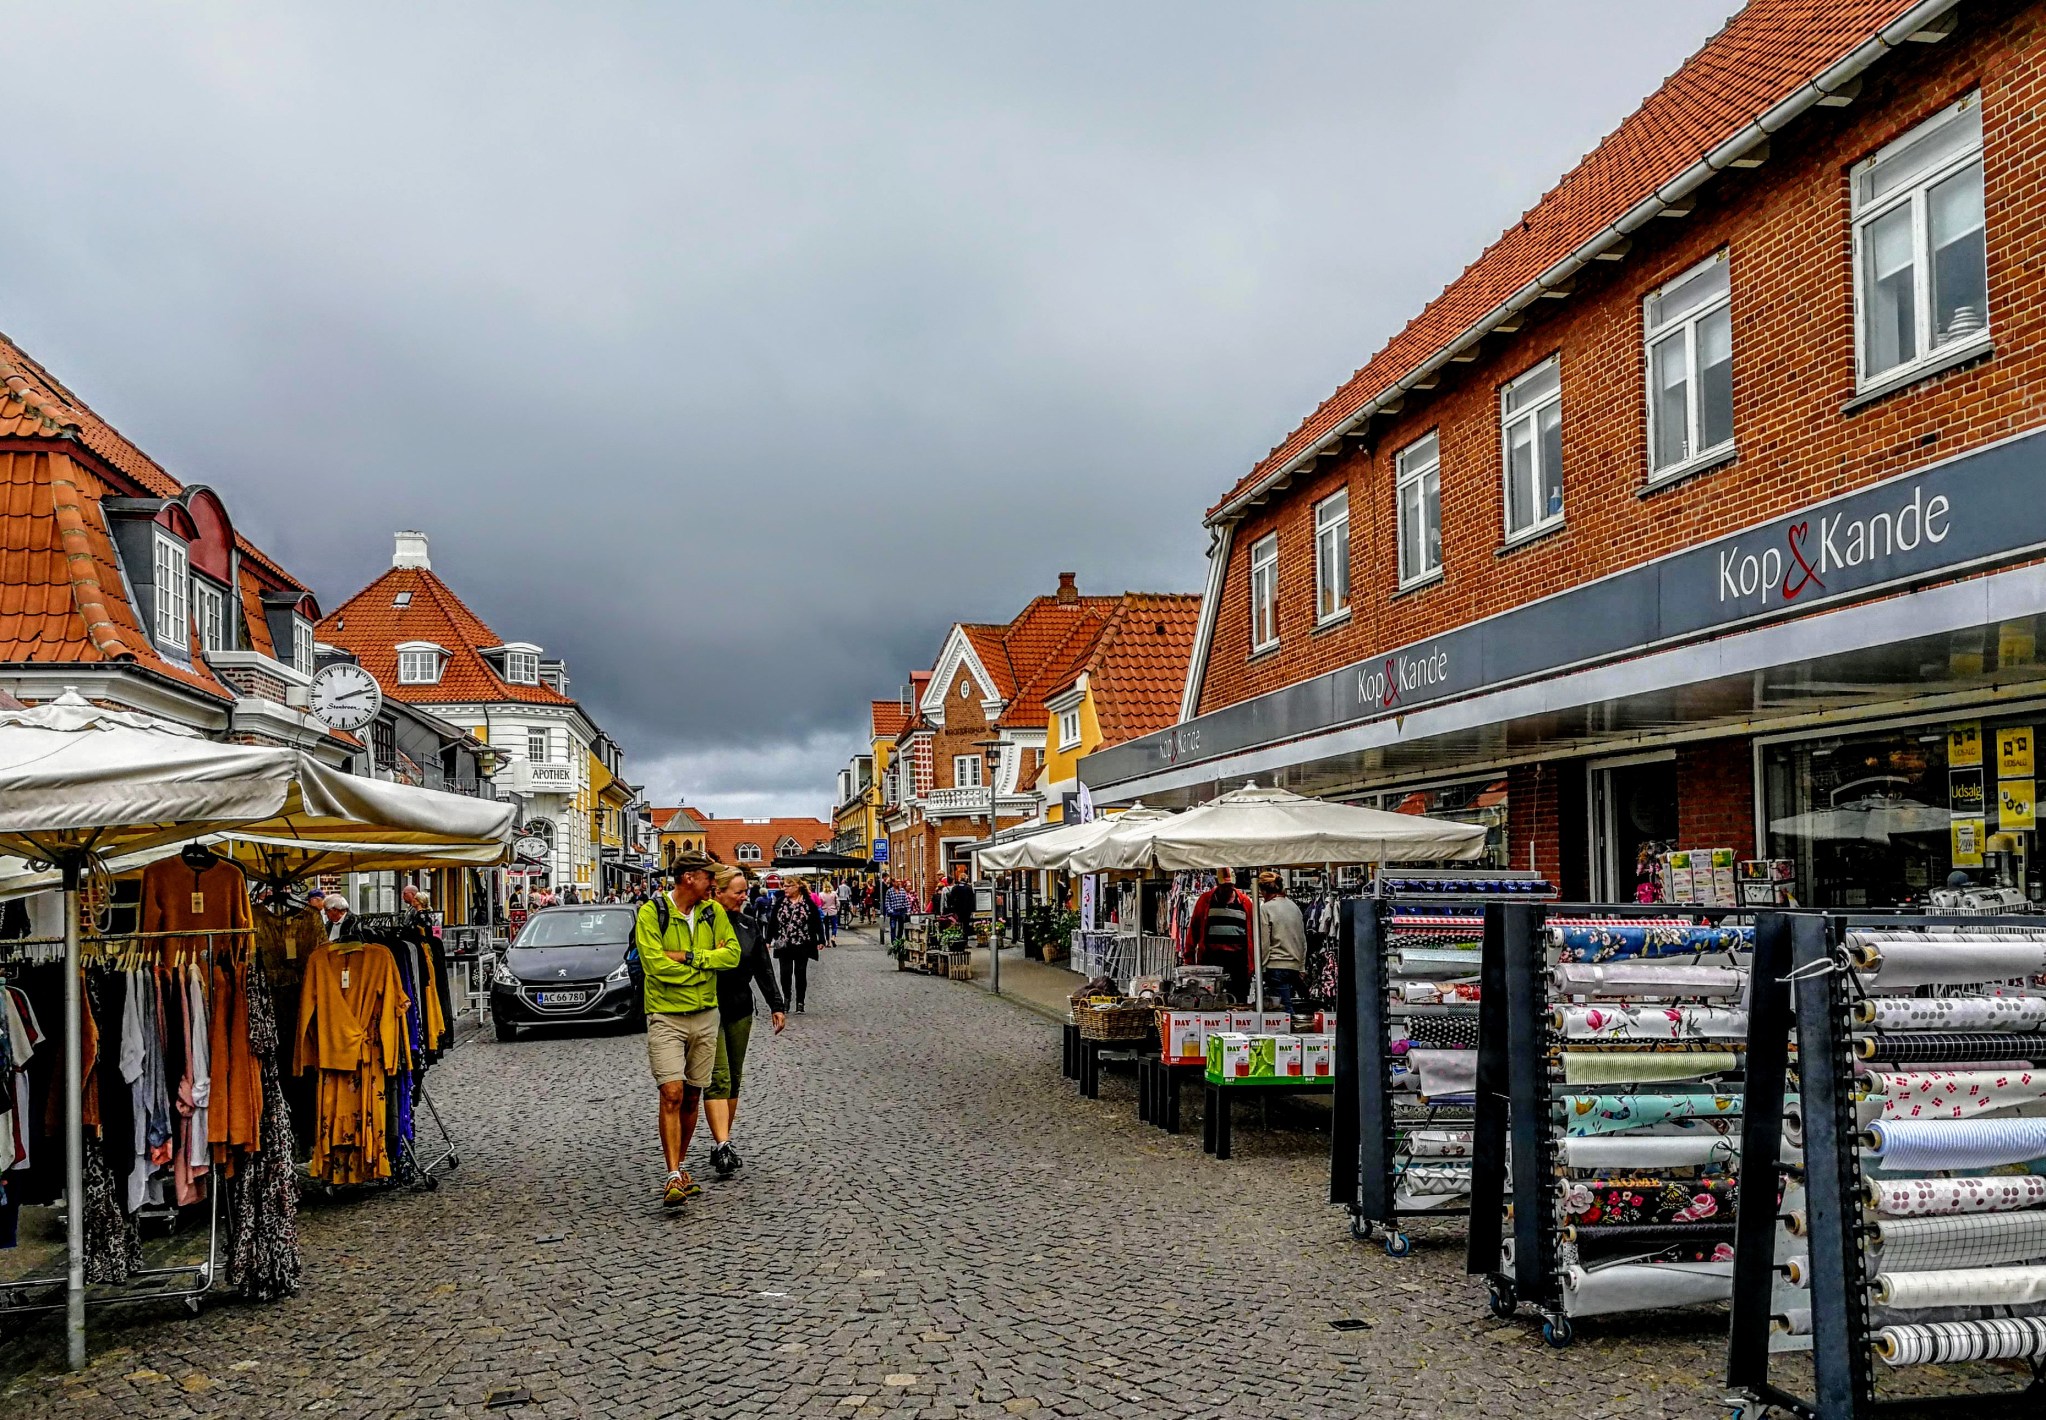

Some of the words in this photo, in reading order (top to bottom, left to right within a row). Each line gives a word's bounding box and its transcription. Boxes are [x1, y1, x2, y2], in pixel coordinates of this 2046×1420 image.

[1719, 546, 1782, 604] Kop
[1820, 485, 1950, 574] Kande
[1358, 668, 1384, 708] Kop
[1399, 645, 1448, 692] Kande
[532, 769, 570, 780] APOTHEK
[1951, 783, 1983, 801] Udsalg
[544, 994, 555, 1002] AC
[556, 993, 567, 1002] 66
[569, 993, 584, 1001] 780
[1204, 1019, 1221, 1027] DAY
